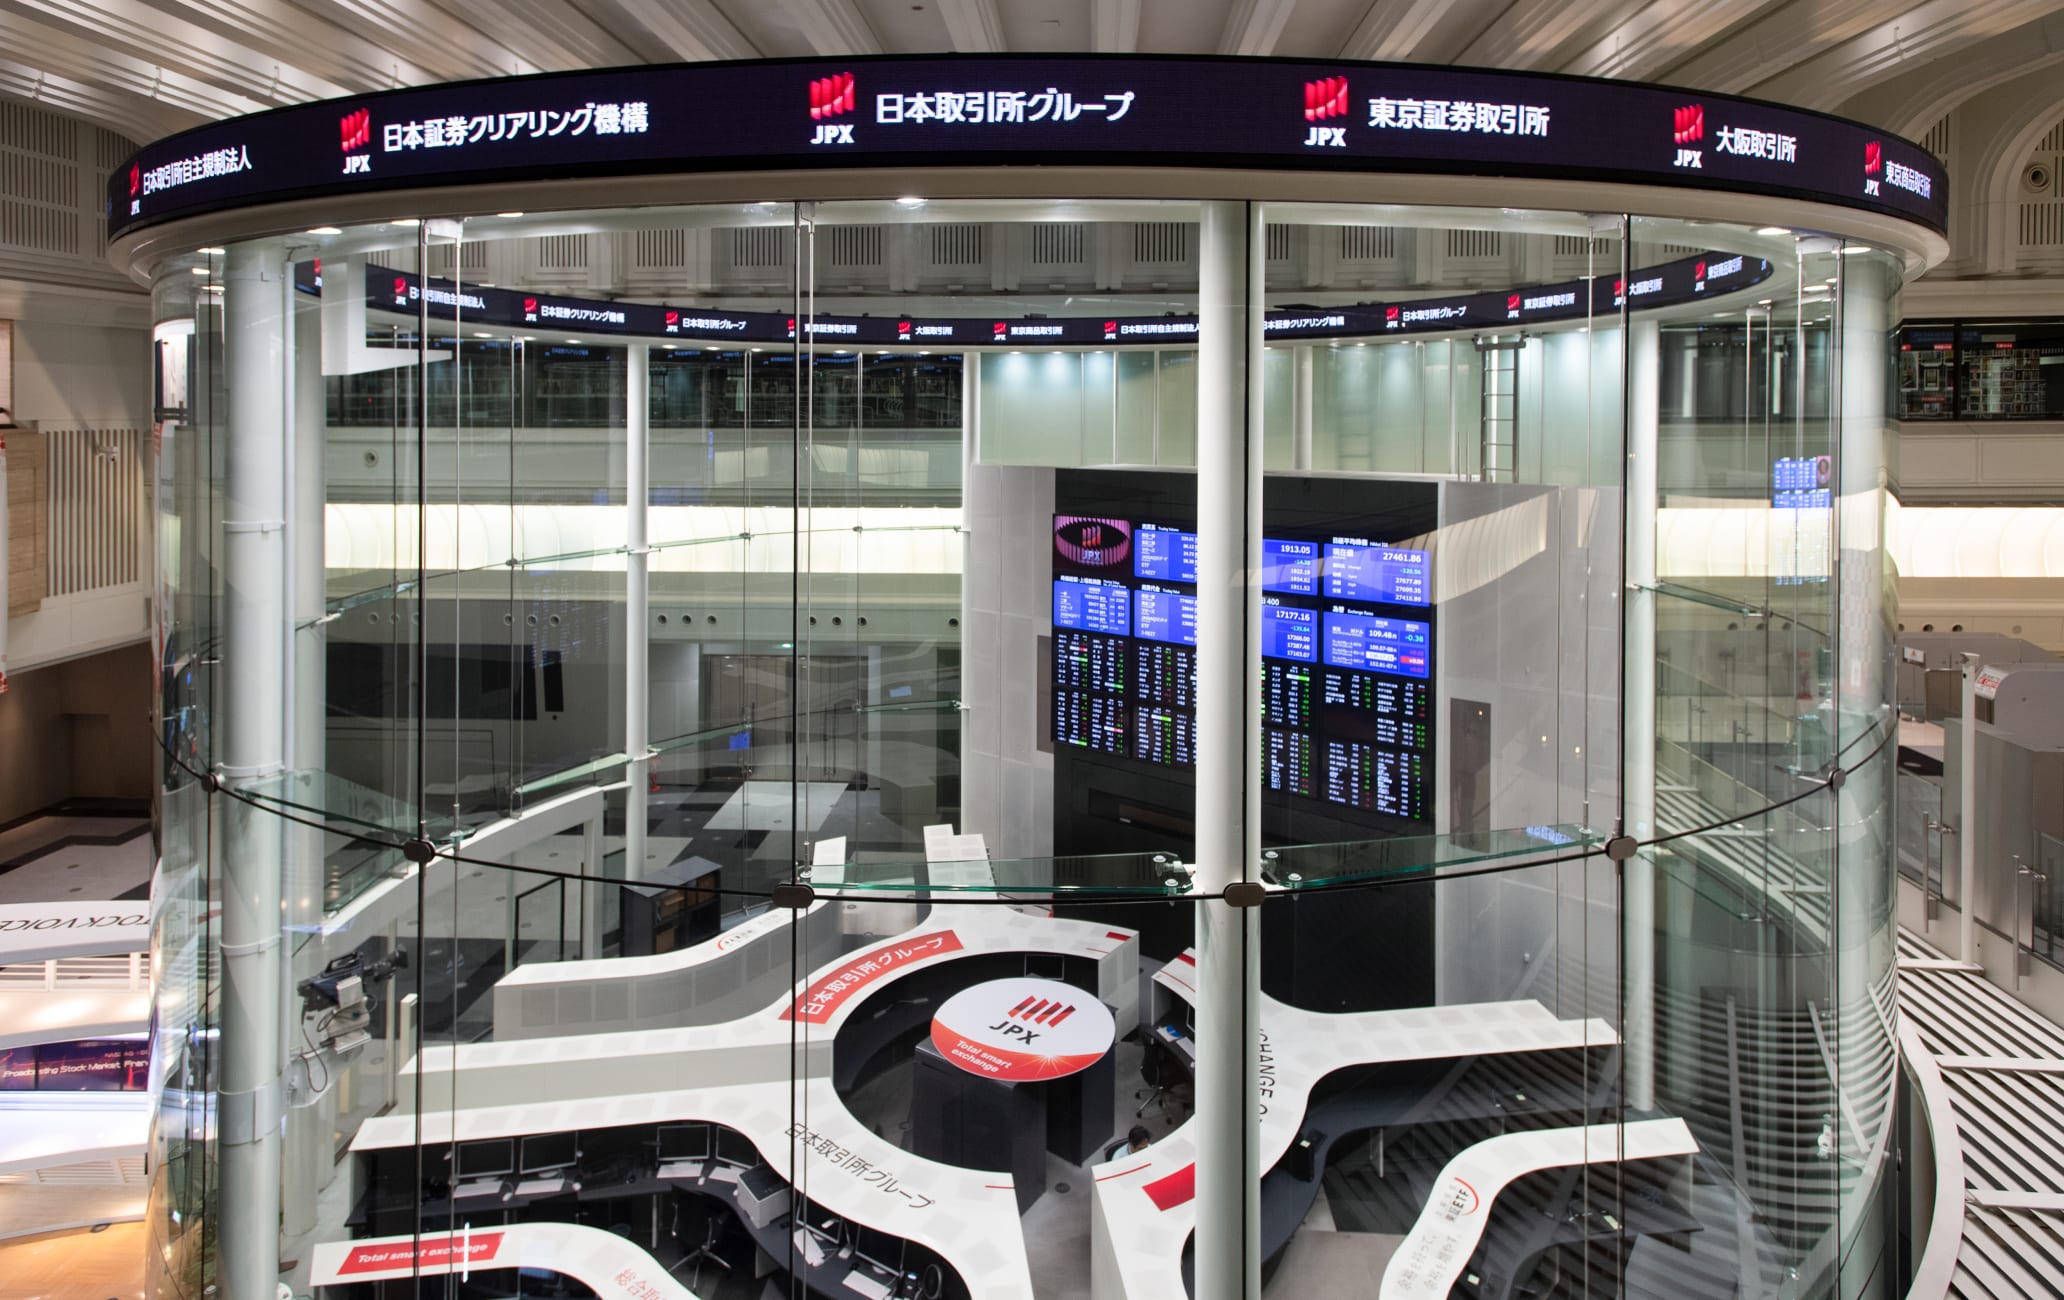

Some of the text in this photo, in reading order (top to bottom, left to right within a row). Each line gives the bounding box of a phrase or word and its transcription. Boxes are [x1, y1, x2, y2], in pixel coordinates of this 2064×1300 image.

[876, 87, 1135, 123] 日本取引所グループ
[1368, 97, 1550, 136] 東京証券取引所
[384, 102, 649, 152] 日本証券クリアリング機構
[810, 124, 854, 145] JPX
[1304, 127, 1347, 147] JPX
[1715, 125, 1797, 163] 大阪取引所
[343, 155, 371, 174] JPX
[1673, 149, 1702, 168] JPX
[143, 144, 253, 195] 日本取引所自主規制法人
[1864, 179, 1879, 197] JPX
[1885, 160, 1931, 200] 東京商品取引所
[541, 305, 625, 323] 日本証券クリアリング機構
[1402, 305, 1467, 322] 日本取引所グループ
[682, 317, 747, 331] 日本取引所グループ
[1082, 550, 1101, 561] JPX
[1281, 544, 1311, 554] 1913.05
[1383, 552, 1422, 563] 27461.86
[1276, 610, 1311, 621] 17177.16
[800, 936, 944, 1026] 日本取引所グループ
[989, 1020, 1040, 1046] JPX
[951, 1048, 999, 1073] exchange
[957, 1040, 1012, 1069] Total smart
[1260, 1028, 1276, 1099] CHANGE
[60, 1064, 87, 1074] Stock
[88, 1061, 121, 1071] Market
[784, 1122, 936, 1209] 日本取引所グループ
[358, 1252, 388, 1264] Total
[390, 1248, 425, 1262] smat
